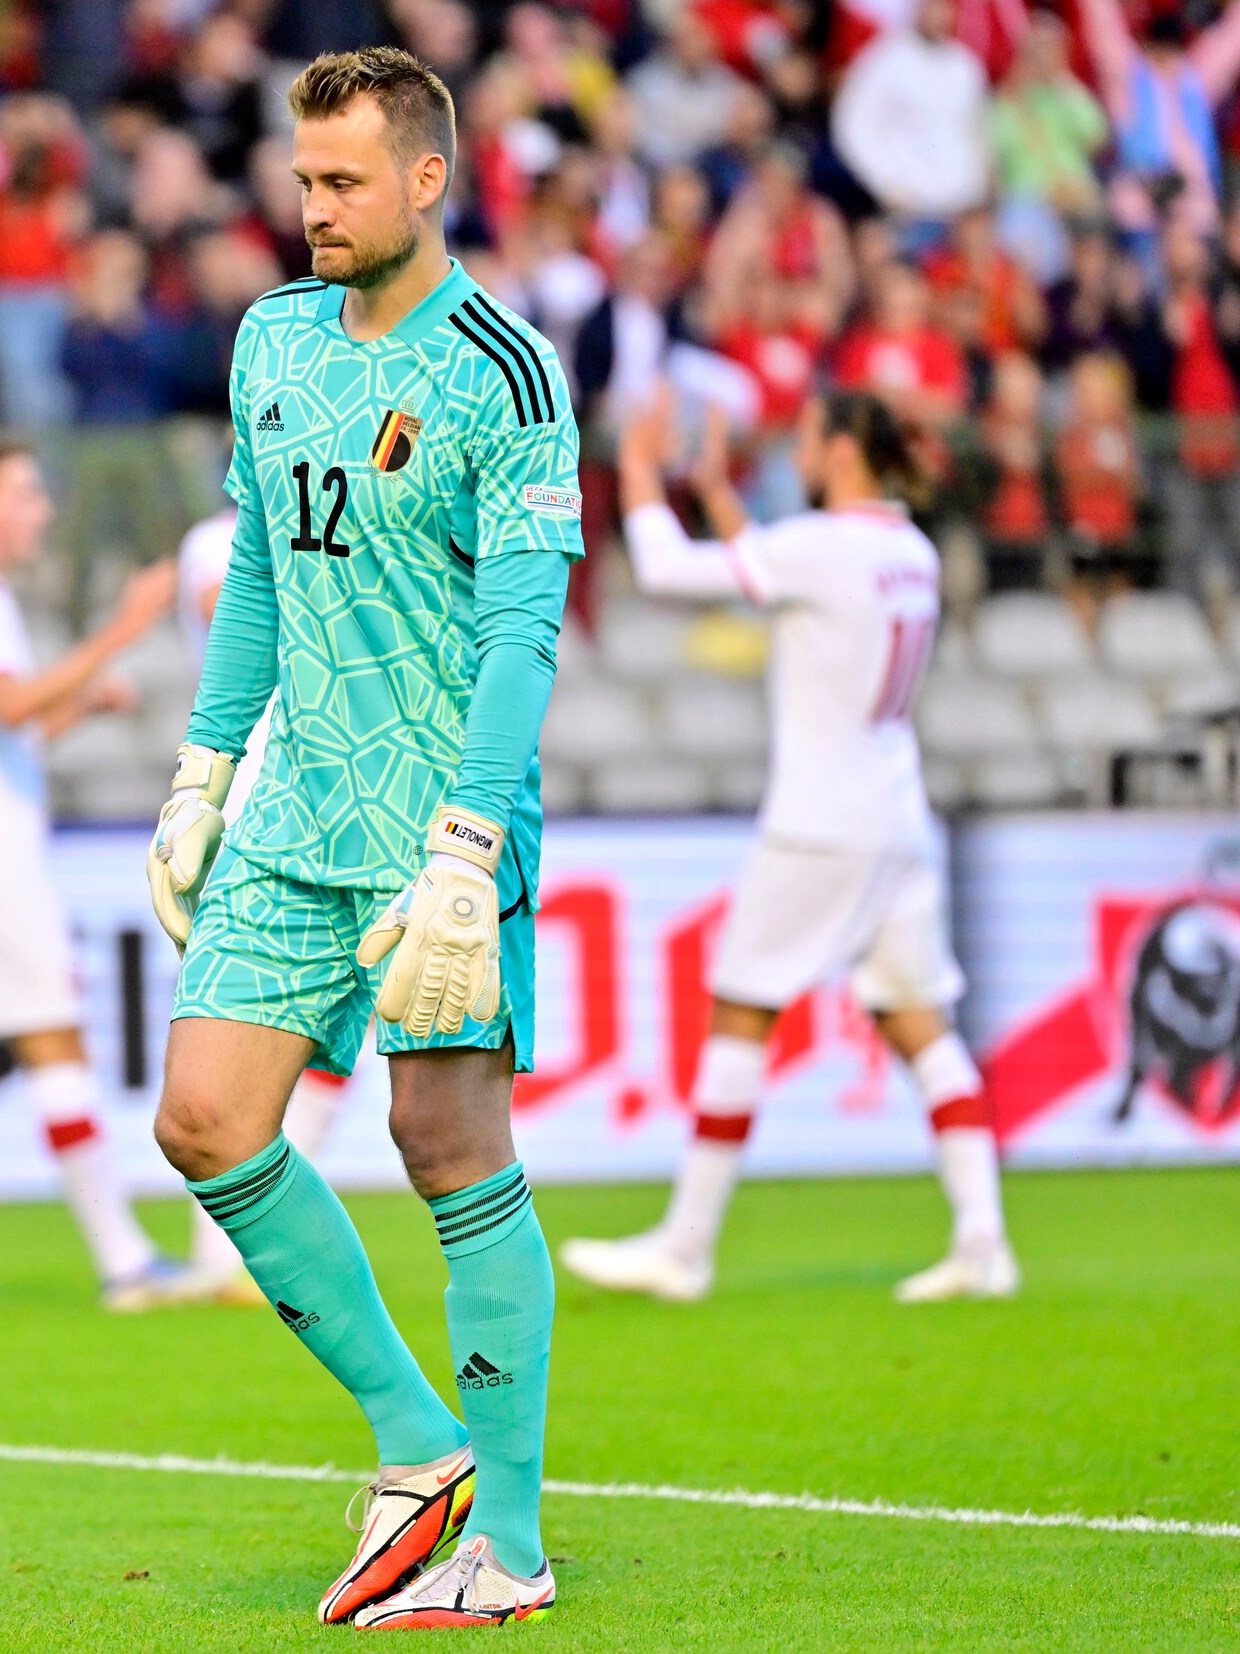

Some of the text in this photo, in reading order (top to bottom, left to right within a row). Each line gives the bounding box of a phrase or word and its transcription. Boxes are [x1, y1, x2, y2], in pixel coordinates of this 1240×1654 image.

[256, 420, 285, 431] adidas
[291, 461, 350, 558] 12
[526, 492, 582, 508] FOUNDATIO
[456, 826, 494, 850] MIGNOLET
[290, 1312, 320, 1333] das
